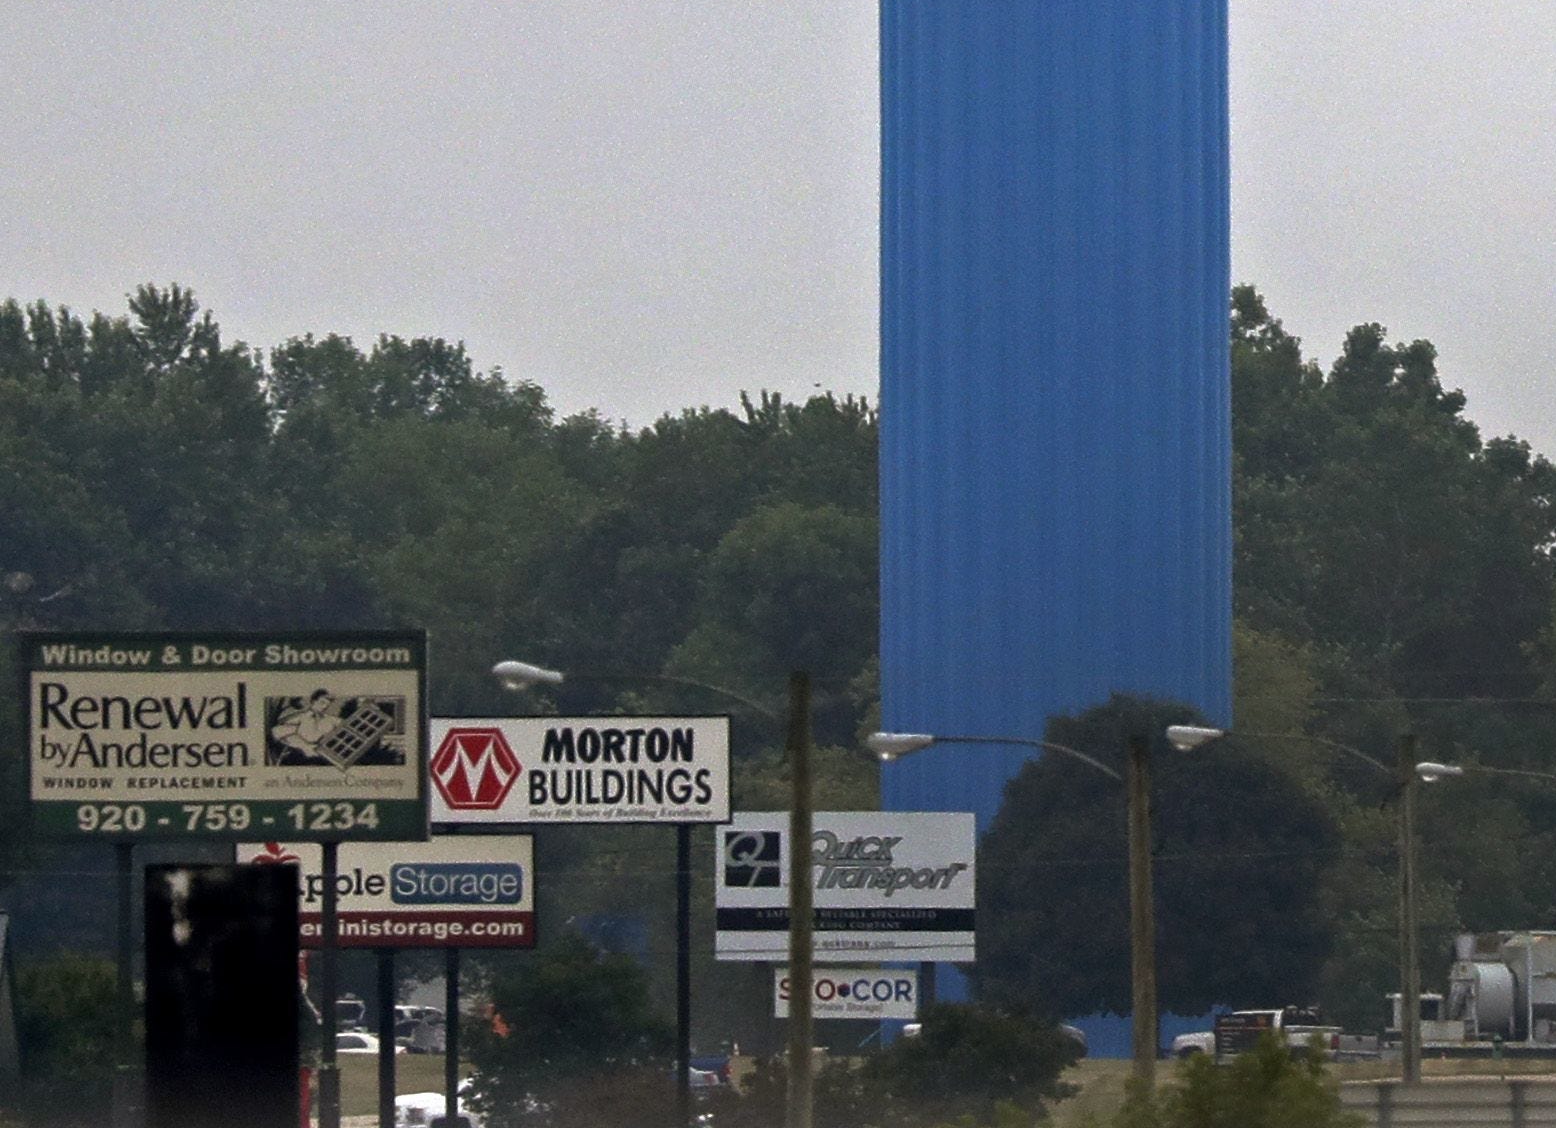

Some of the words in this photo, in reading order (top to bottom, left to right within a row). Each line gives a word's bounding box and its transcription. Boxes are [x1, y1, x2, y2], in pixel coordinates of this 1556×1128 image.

[42, 645, 150, 665] Window
[161, 645, 181, 665] &
[192, 645, 256, 665] Door
[265, 644, 410, 664] Showroom
[40, 682, 247, 730] Renewal
[541, 727, 695, 764] MORTON
[43, 777, 114, 789] WINDOW
[127, 776, 248, 789] REPLACEMENT
[528, 768, 712, 806] BUILDINGS
[77, 805, 146, 832] 920
[182, 804, 250, 831] 759
[287, 803, 379, 831] 1234
[300, 868, 384, 902] pple
[396, 867, 518, 902] Storage
